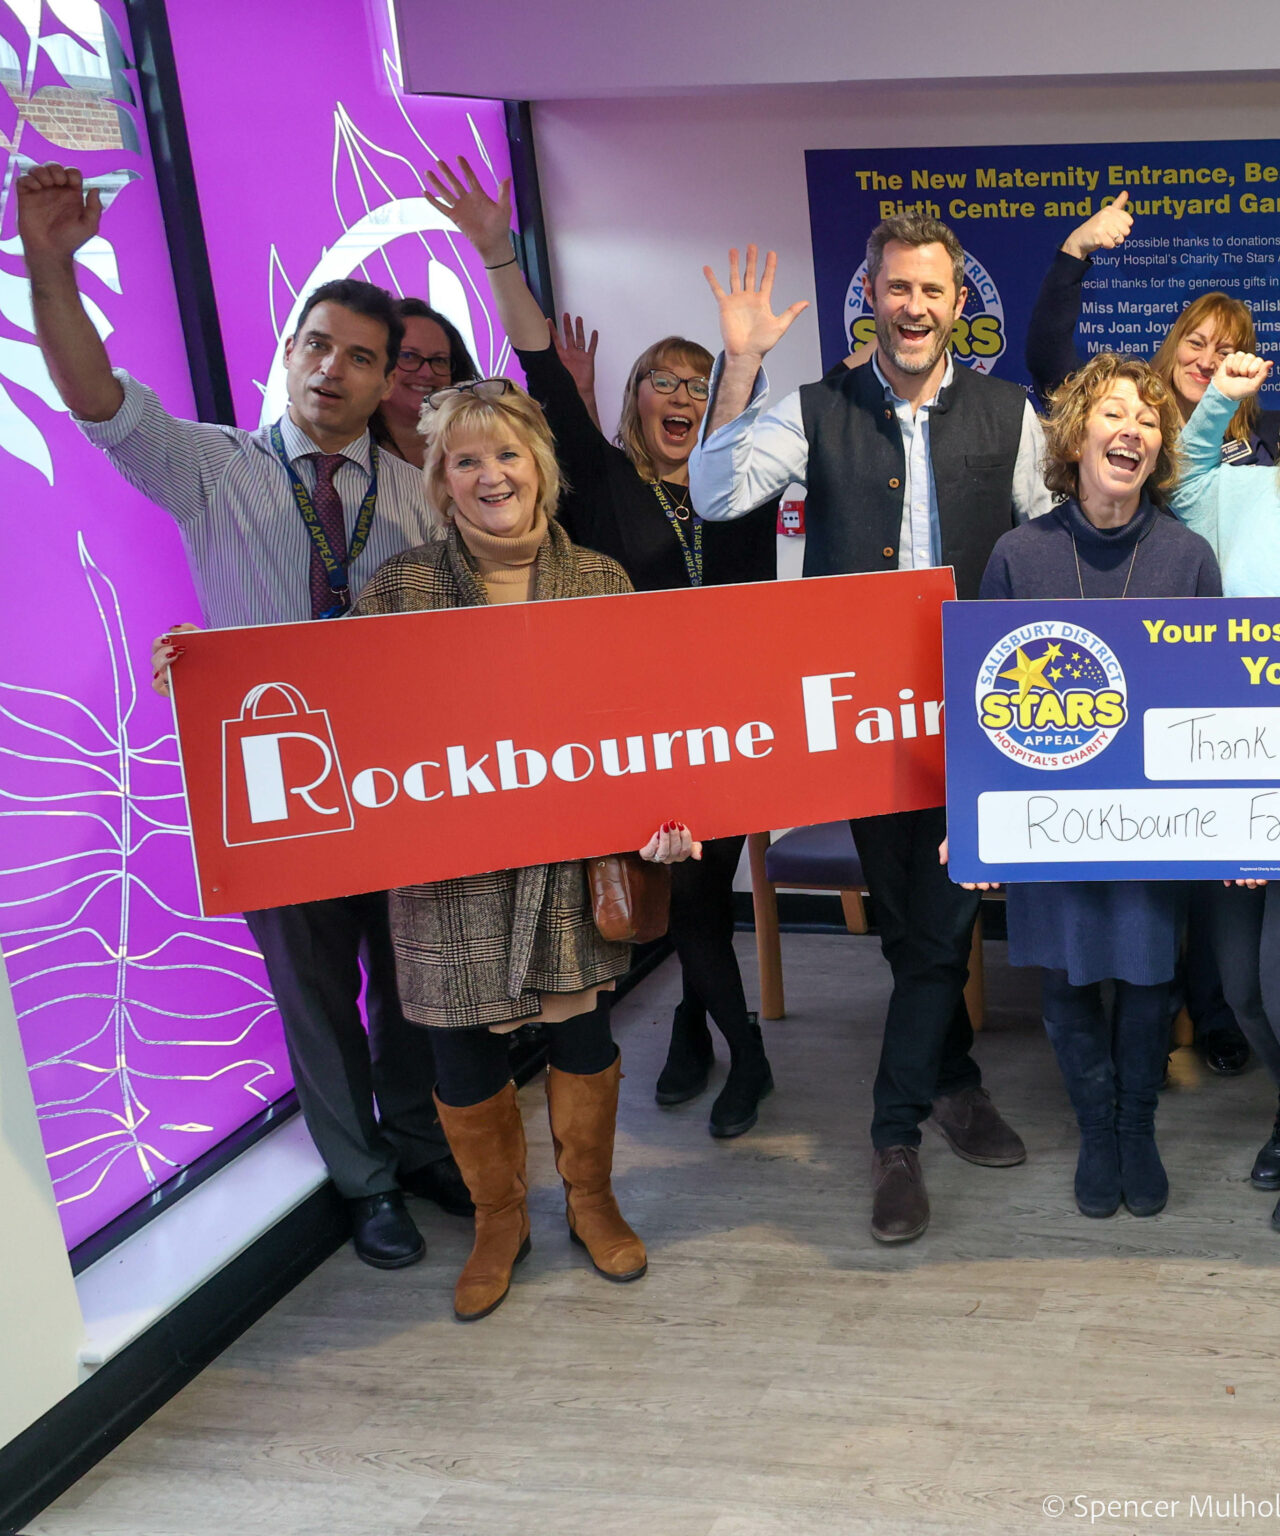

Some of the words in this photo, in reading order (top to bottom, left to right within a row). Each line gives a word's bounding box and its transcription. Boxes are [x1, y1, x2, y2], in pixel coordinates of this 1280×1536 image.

[855, 171, 903, 190] The
[911, 169, 967, 190] New
[975, 166, 1099, 191] Maternity
[1108, 165, 1235, 187] Entrance,
[949, 198, 1035, 219] Centre
[1044, 197, 1091, 217] and
[1124, 237, 1170, 250] possible
[1173, 237, 1209, 248] thanks
[1212, 237, 1223, 247] to
[1226, 235, 1280, 247] donations
[1123, 253, 1177, 267] Hospital's
[1180, 253, 1219, 266] Charity
[1221, 253, 1243, 264] The
[1246, 252, 1275, 263] Stars
[1111, 277, 1148, 288] thanks
[1150, 277, 1165, 288] for
[1167, 277, 1185, 288] the
[1188, 278, 1240, 290] generous
[1243, 276, 1266, 289] gifts
[1269, 276, 1279, 287] in
[1082, 301, 1114, 314] Miss
[1117, 301, 1179, 316] Margaret
[1079, 321, 1105, 333] Mrs
[1108, 321, 1141, 333] Joan
[1087, 341, 1113, 353] Mrs
[1116, 341, 1149, 353] Jean
[294, 483, 318, 522] STARS
[1142, 619, 1217, 643] Your
[981, 624, 1055, 686] SALISBURY
[1061, 625, 1123, 683] DISTRICT
[981, 691, 1125, 729] STARS
[994, 731, 1058, 767] HOSPITAL'S
[1062, 731, 1109, 765] CHARITY
[1023, 735, 1083, 746] APPEAL
[1168, 713, 1276, 763] Thank
[240, 720, 775, 825] Rockbourne
[1026, 795, 1218, 849] Rockbourne
